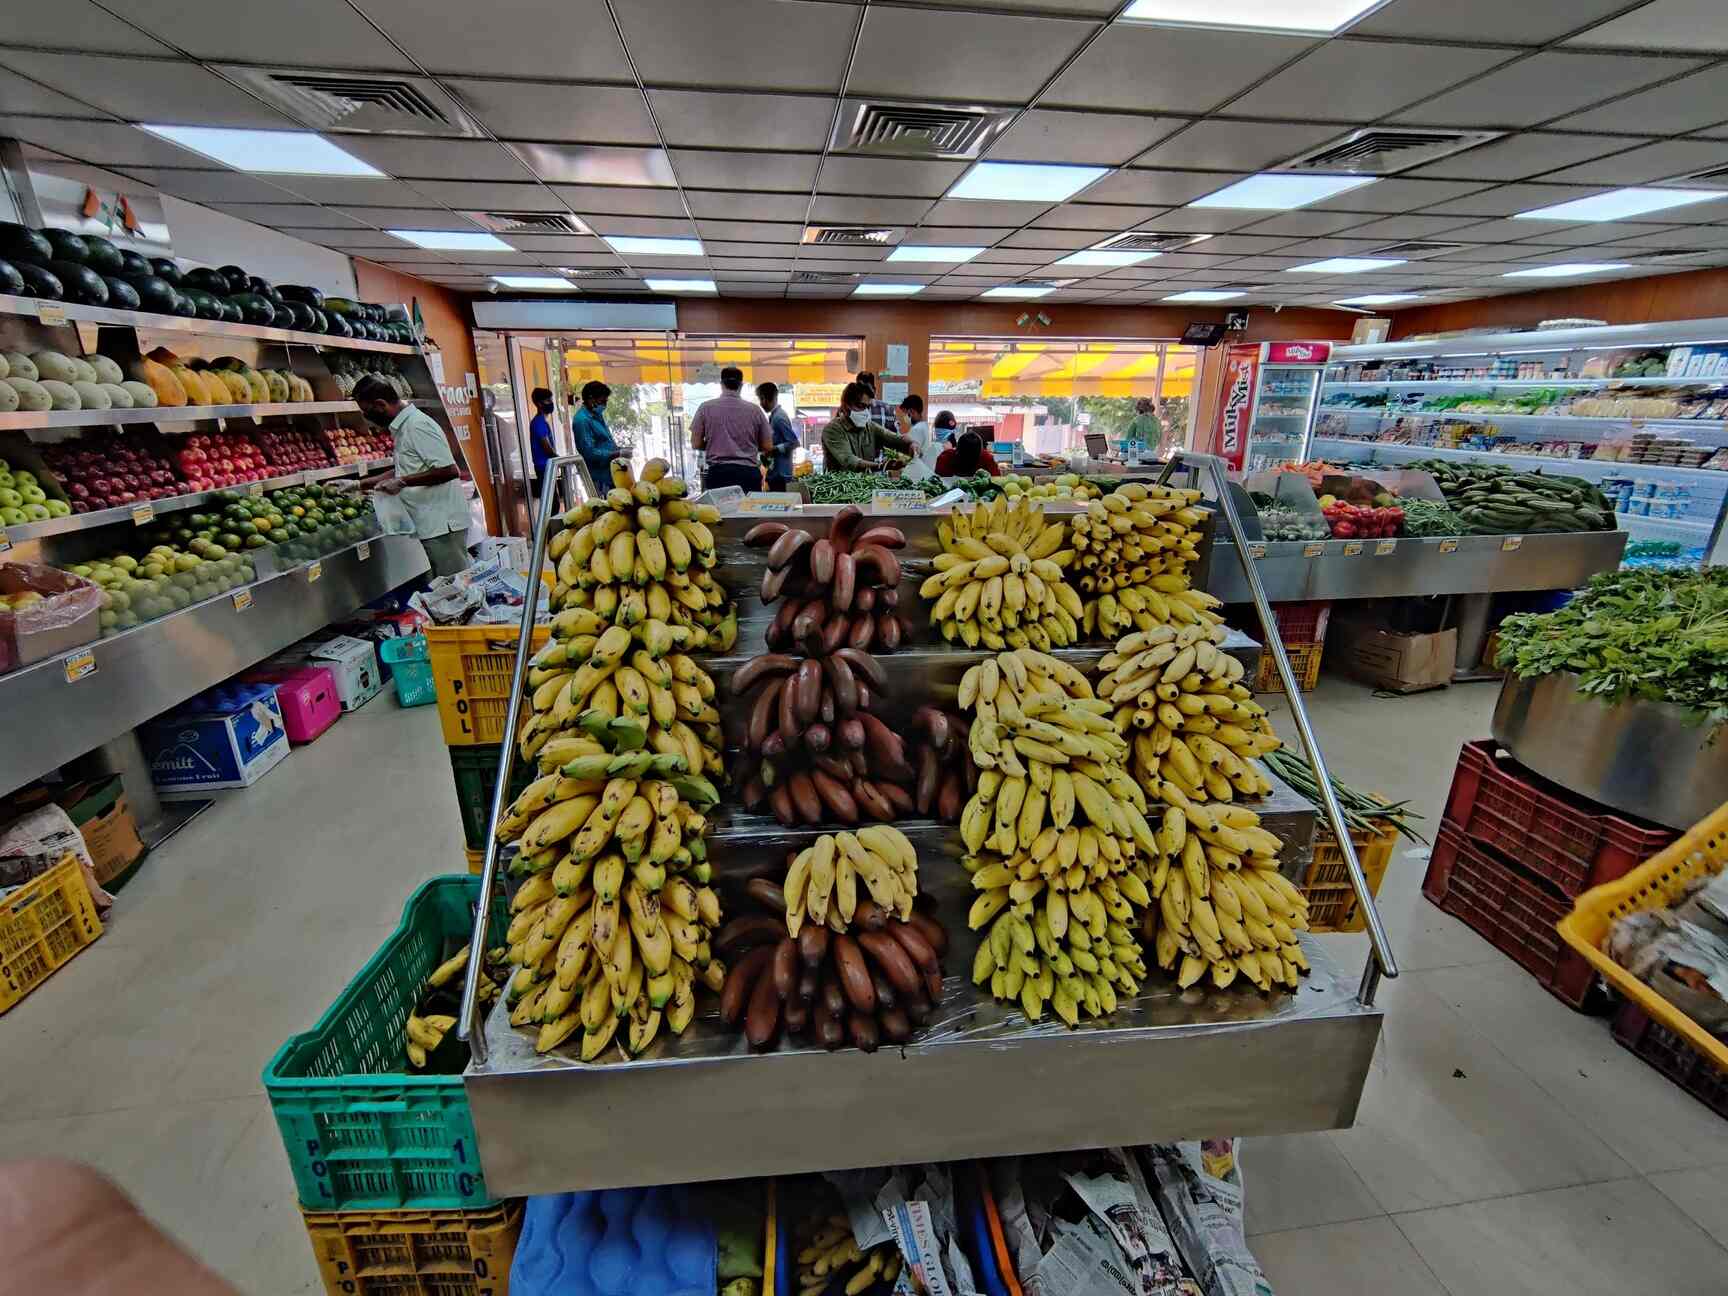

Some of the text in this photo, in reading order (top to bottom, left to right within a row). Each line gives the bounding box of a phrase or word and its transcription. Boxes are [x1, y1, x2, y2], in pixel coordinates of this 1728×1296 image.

[1224, 388, 1240, 449] Milky
[1236, 363, 1249, 405] Mist
[452, 679, 472, 734] POL
[306, 1139, 332, 1199] POL
